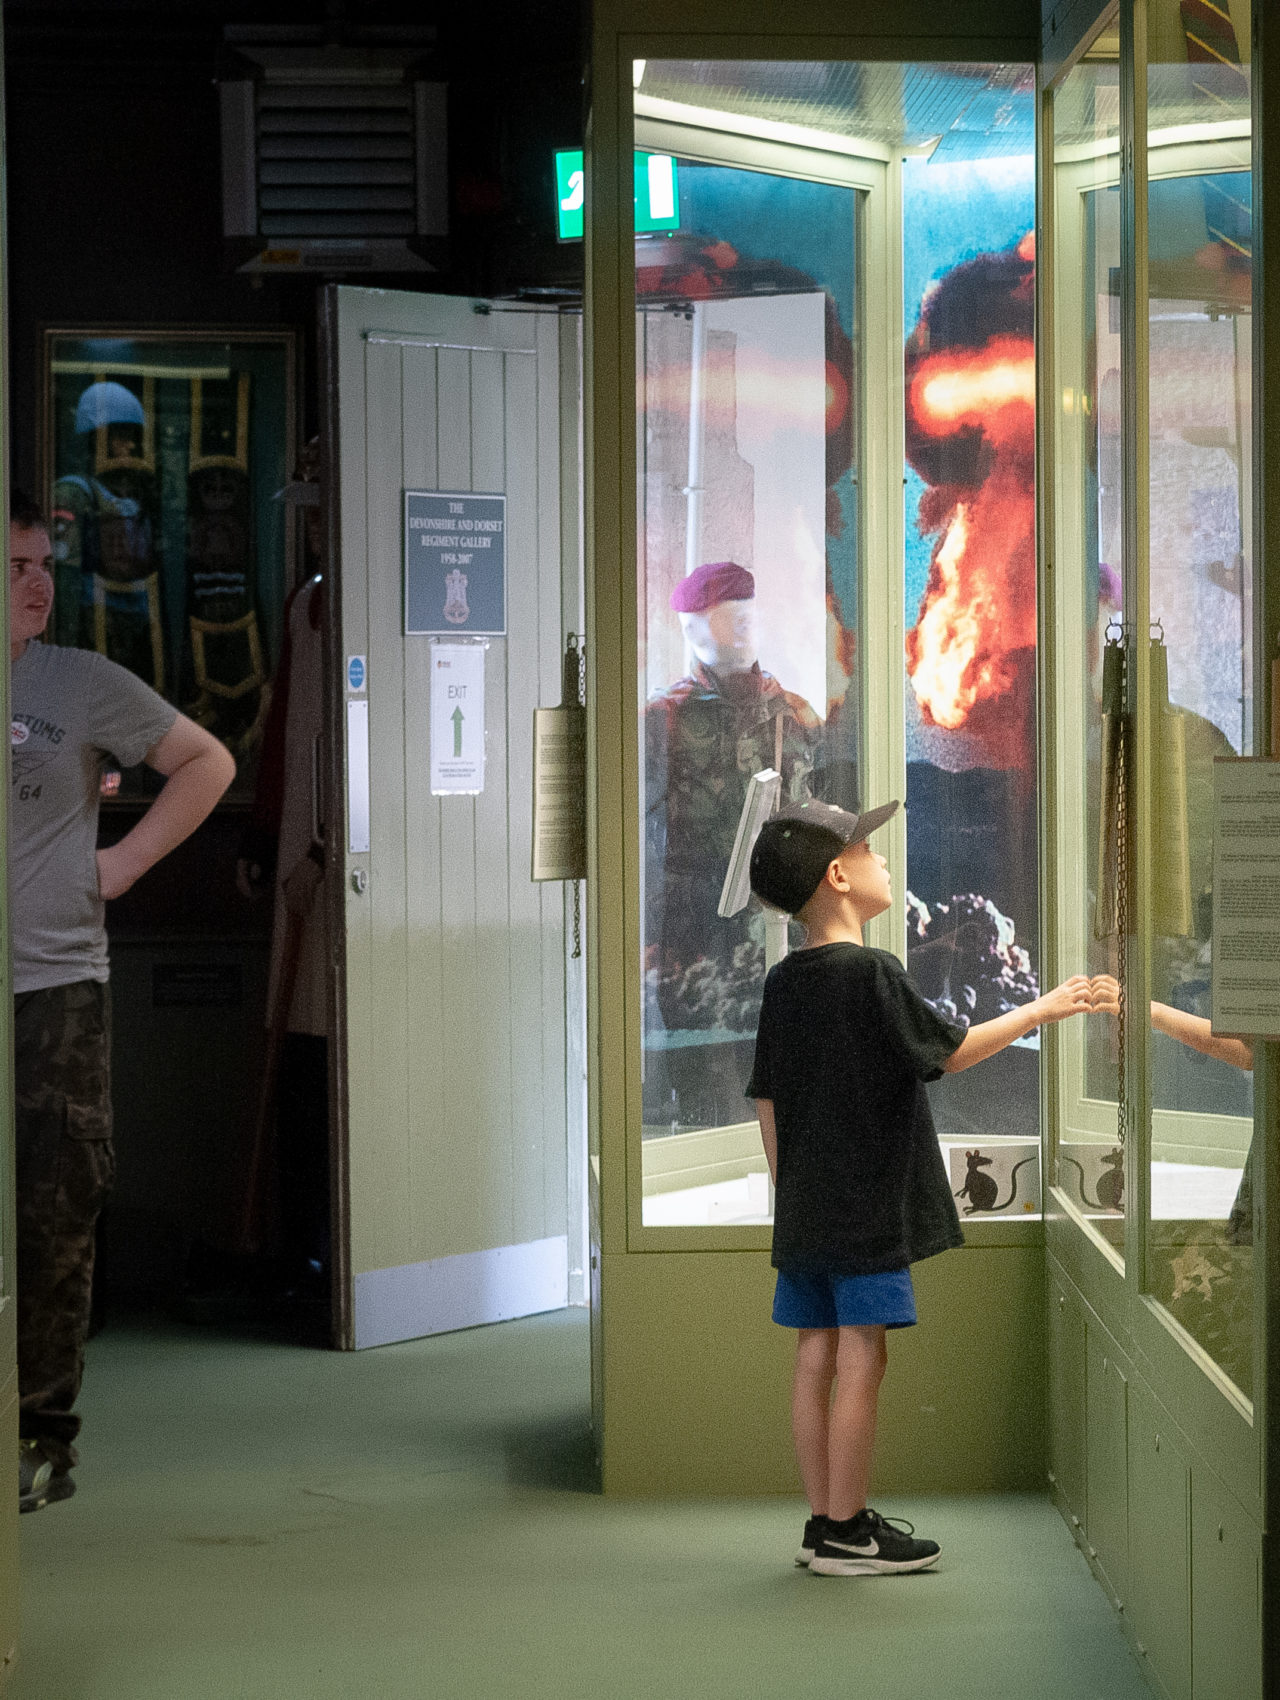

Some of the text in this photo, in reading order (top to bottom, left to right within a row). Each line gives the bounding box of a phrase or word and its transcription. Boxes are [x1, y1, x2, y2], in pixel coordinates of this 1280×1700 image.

[448, 502, 464, 514] THE
[409, 517, 503, 532] DEVONSHIRE AND DORSET
[421, 535, 492, 548] REGIMENT GALLERY
[448, 685, 467, 699] EXIT
[20, 784, 42, 801] 64
